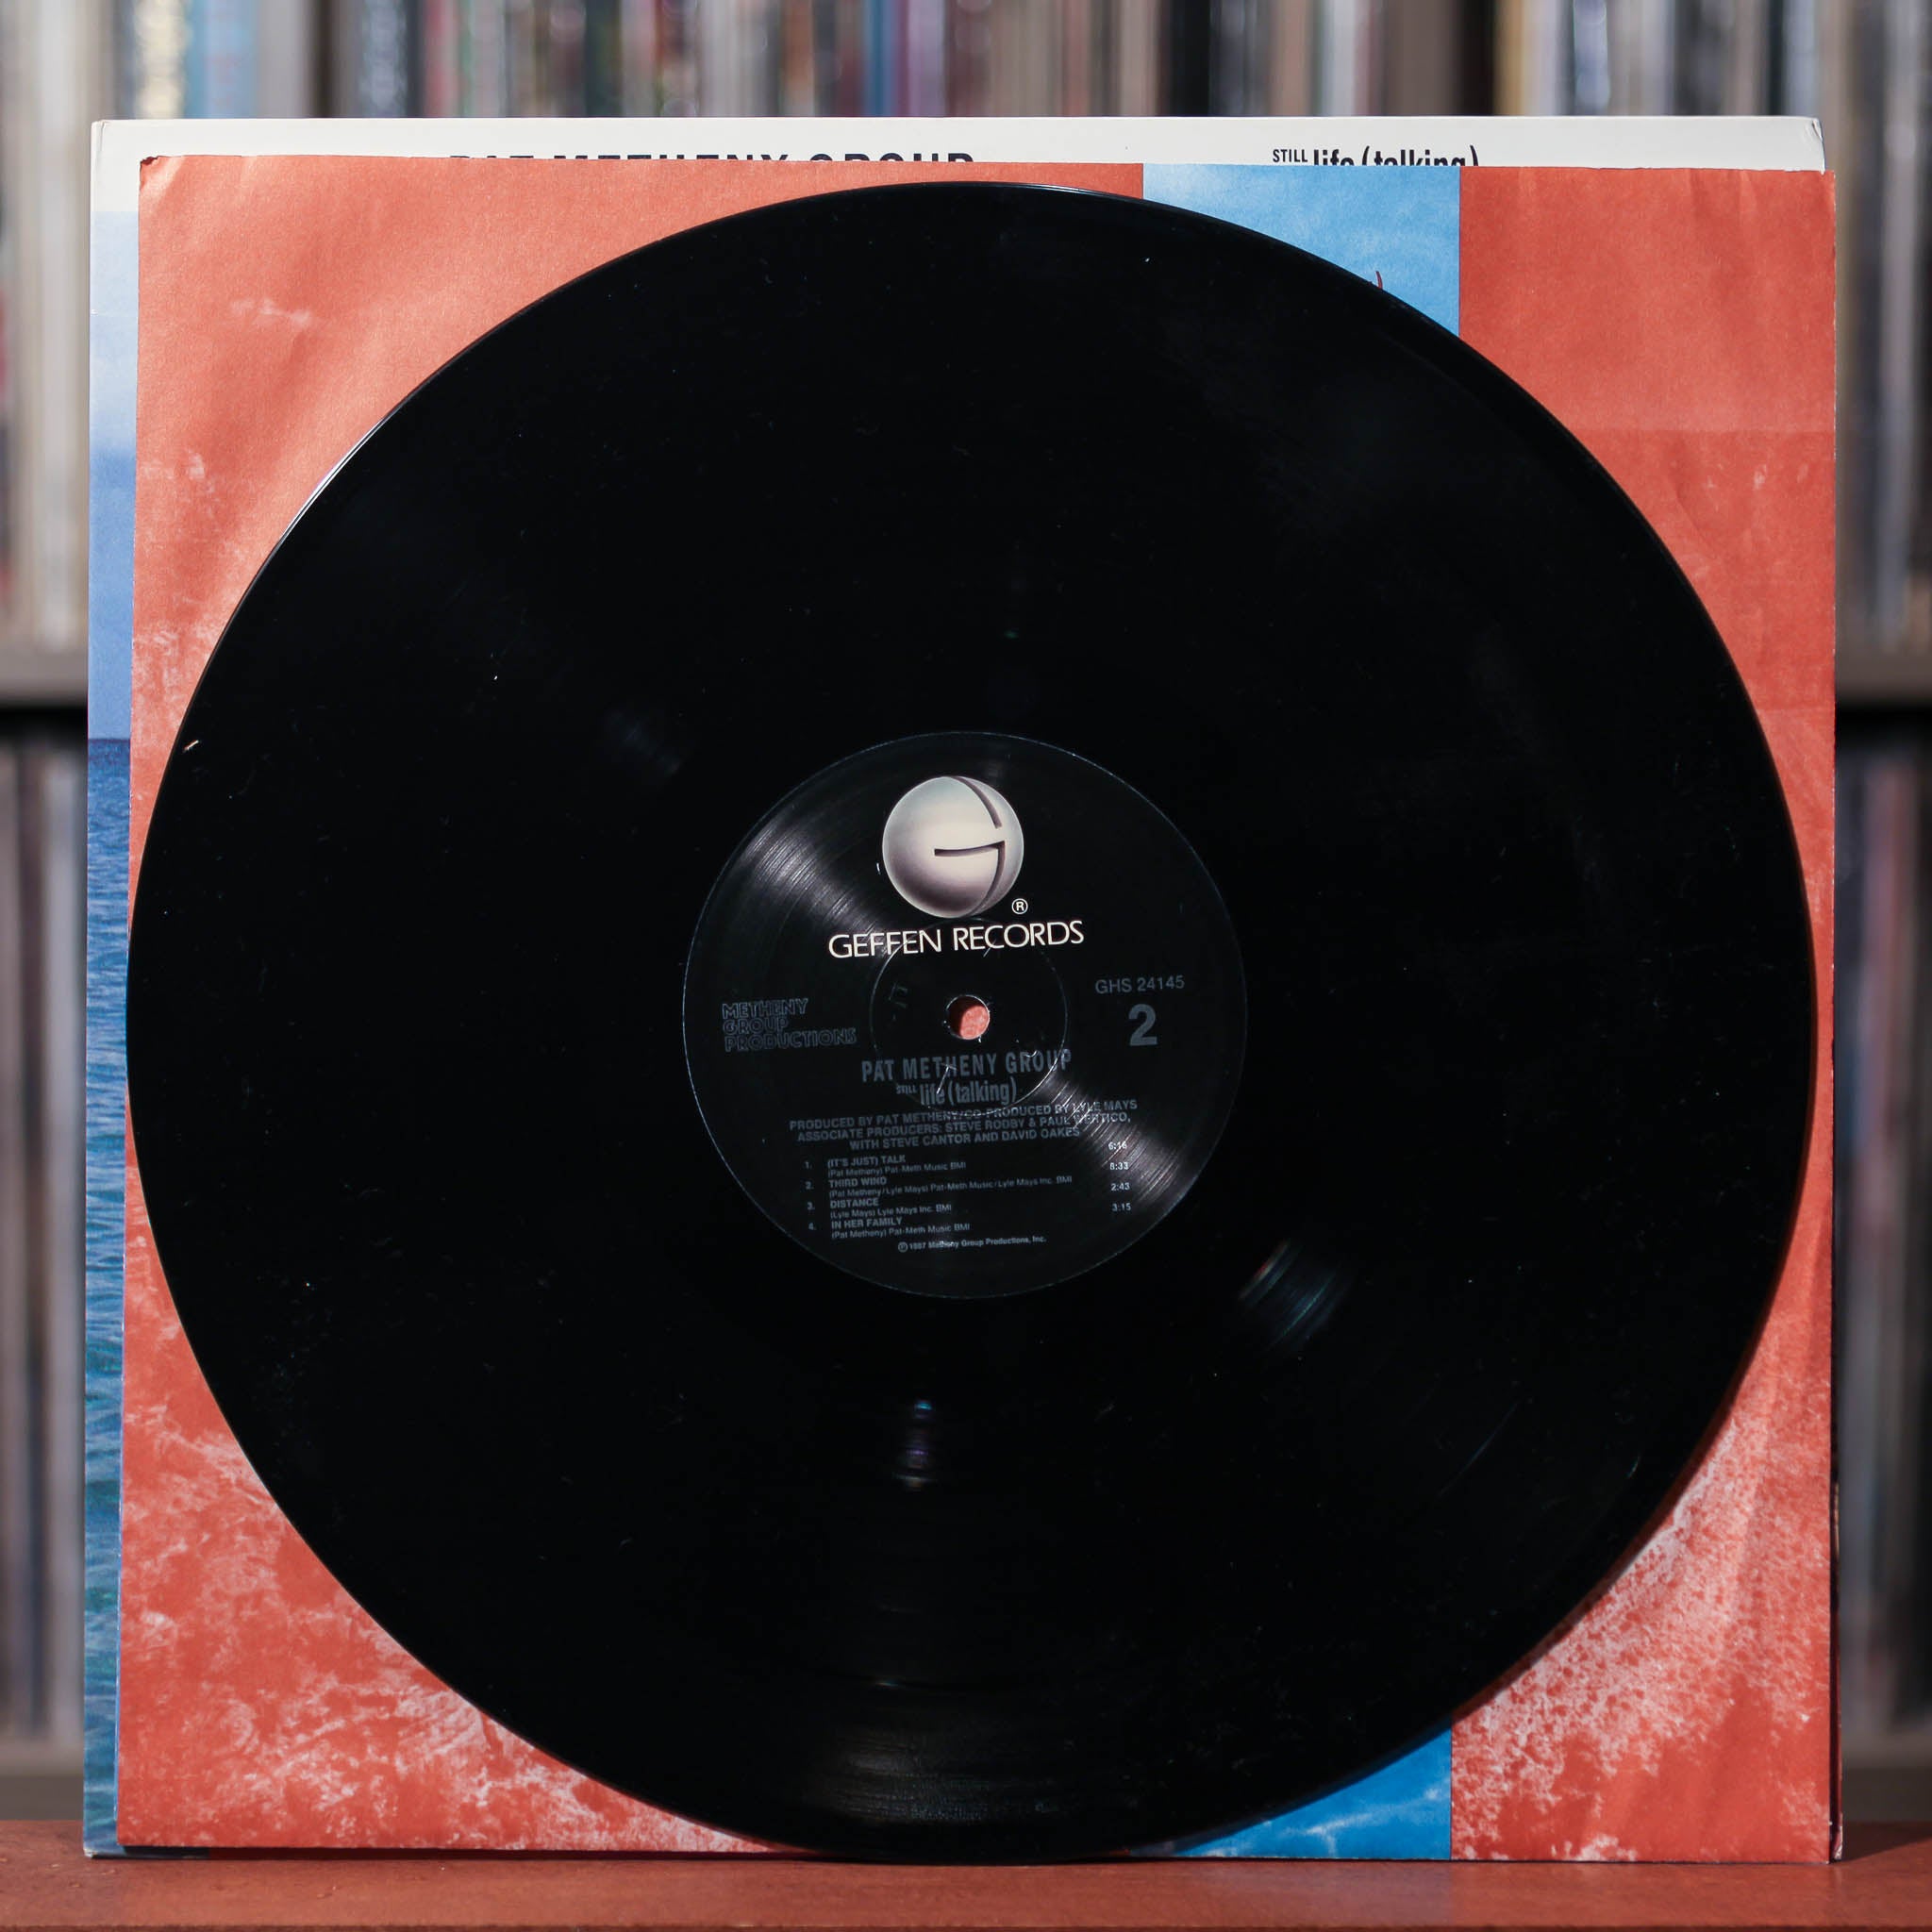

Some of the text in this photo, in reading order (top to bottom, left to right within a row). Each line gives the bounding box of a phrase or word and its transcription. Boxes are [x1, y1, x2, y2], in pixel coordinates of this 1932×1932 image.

[1273, 149, 1307, 162] STILL
[828, 920, 1085, 958] GEFFEN RECORDS
[1094, 974, 1185, 994] GHS 24145
[722, 997, 808, 1019] METHENY
[723, 1016, 789, 1036] GROUP
[1127, 1004, 1158, 1047] 2
[724, 1026, 858, 1053] PRODUCTIONS
[861, 1048, 1072, 1082] PAT METHENY GROUP
[895, 1076, 1017, 1106] STILL life (talking)
[789, 1116, 855, 1131] PRODUCED
[858, 1115, 873, 1127] BY
[875, 1113, 899, 1125] PAT
[1055, 1104, 1069, 1114] BY
[1104, 1099, 1138, 1110] MAYS
[796, 1128, 863, 1142] ASSOCIATE
[867, 1123, 942, 1137] PRODUCERS:
[945, 1120, 981, 1133] STEVE
[984, 1117, 1024, 1130] RODBY
[1028, 1116, 1036, 1128] &
[1039, 1115, 1070, 1127] PAUL
[849, 1125, 1080, 1151] WITH STEVE CANTOR AND DAVID OAKES
[850, 1156, 878, 1167] JUST)
[881, 1154, 906, 1165] TALK
[828, 1178, 858, 1189] THIRD
[860, 1175, 887, 1186] WIND
[829, 1198, 879, 1209] DISTANCE
[1110, 1182, 1130, 1191] 2:43
[831, 1220, 841, 1230] IN
[844, 1218, 864, 1228] HER
[866, 1216, 903, 1227] FAMILY
[1112, 1203, 1132, 1212] 3:15
[960, 1238, 984, 1248] Group
